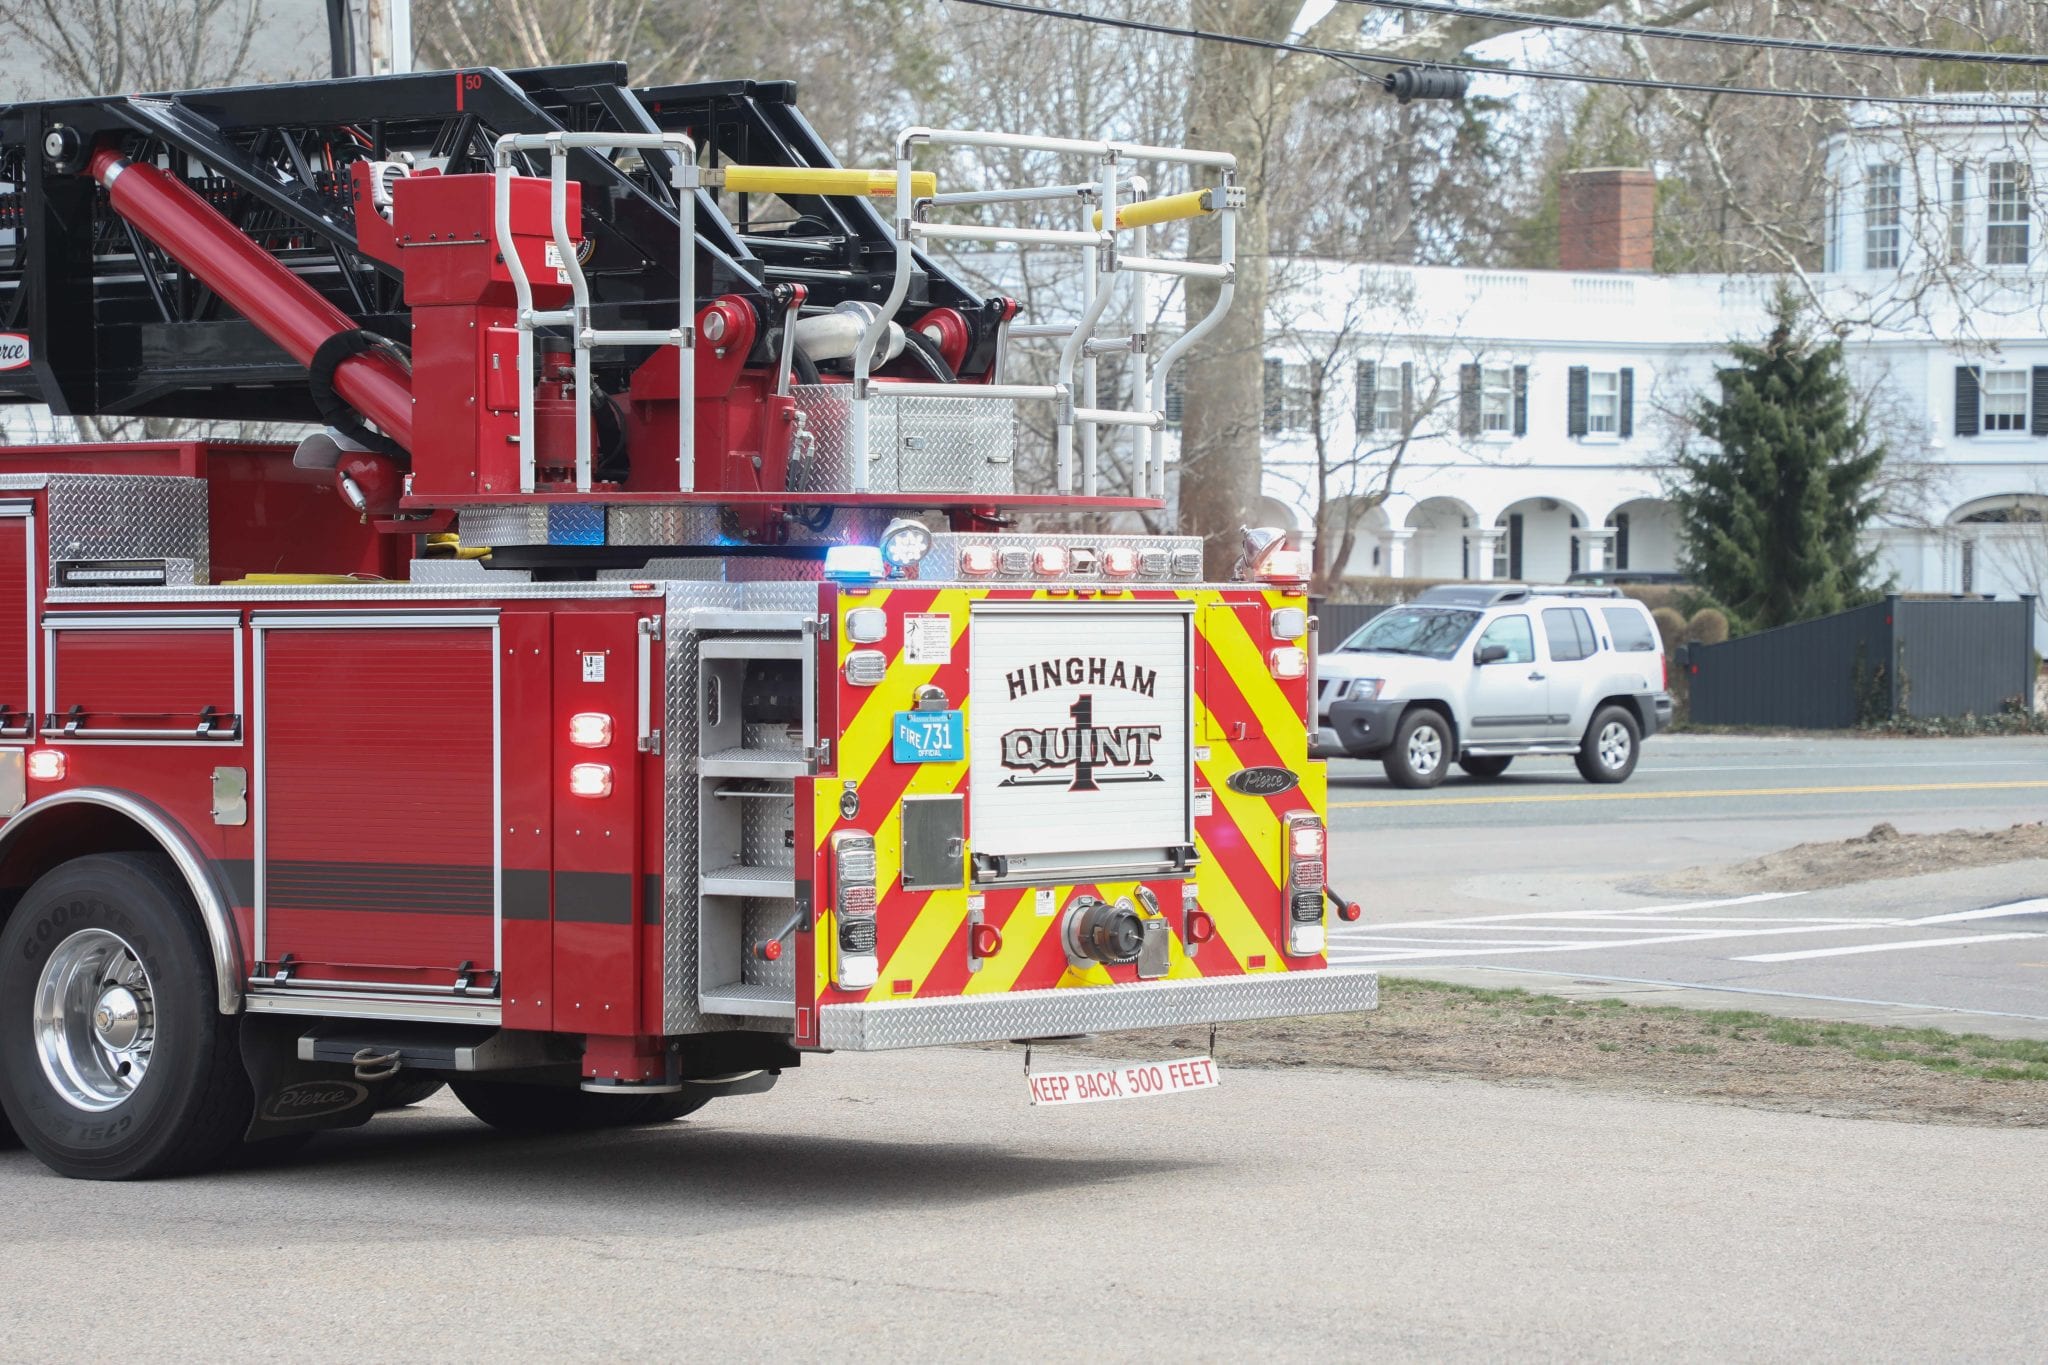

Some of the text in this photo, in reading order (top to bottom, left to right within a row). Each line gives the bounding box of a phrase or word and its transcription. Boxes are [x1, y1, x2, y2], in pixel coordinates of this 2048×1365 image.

[465, 75, 482, 90] 50
[0, 344, 25, 359] rce
[1005, 657, 1157, 701] HINGHAM
[900, 723, 952, 749] FIRE 731
[1067, 694, 1100, 793] 1
[918, 749, 942, 757] OFFICIAL
[1000, 725, 1162, 774] QUINT
[1243, 770, 1284, 792] Pierce
[23, 898, 162, 982] GOODYEAR
[1029, 1059, 1214, 1102] KEEP BACK 500 FEET
[273, 1089, 345, 1113] Pierce
